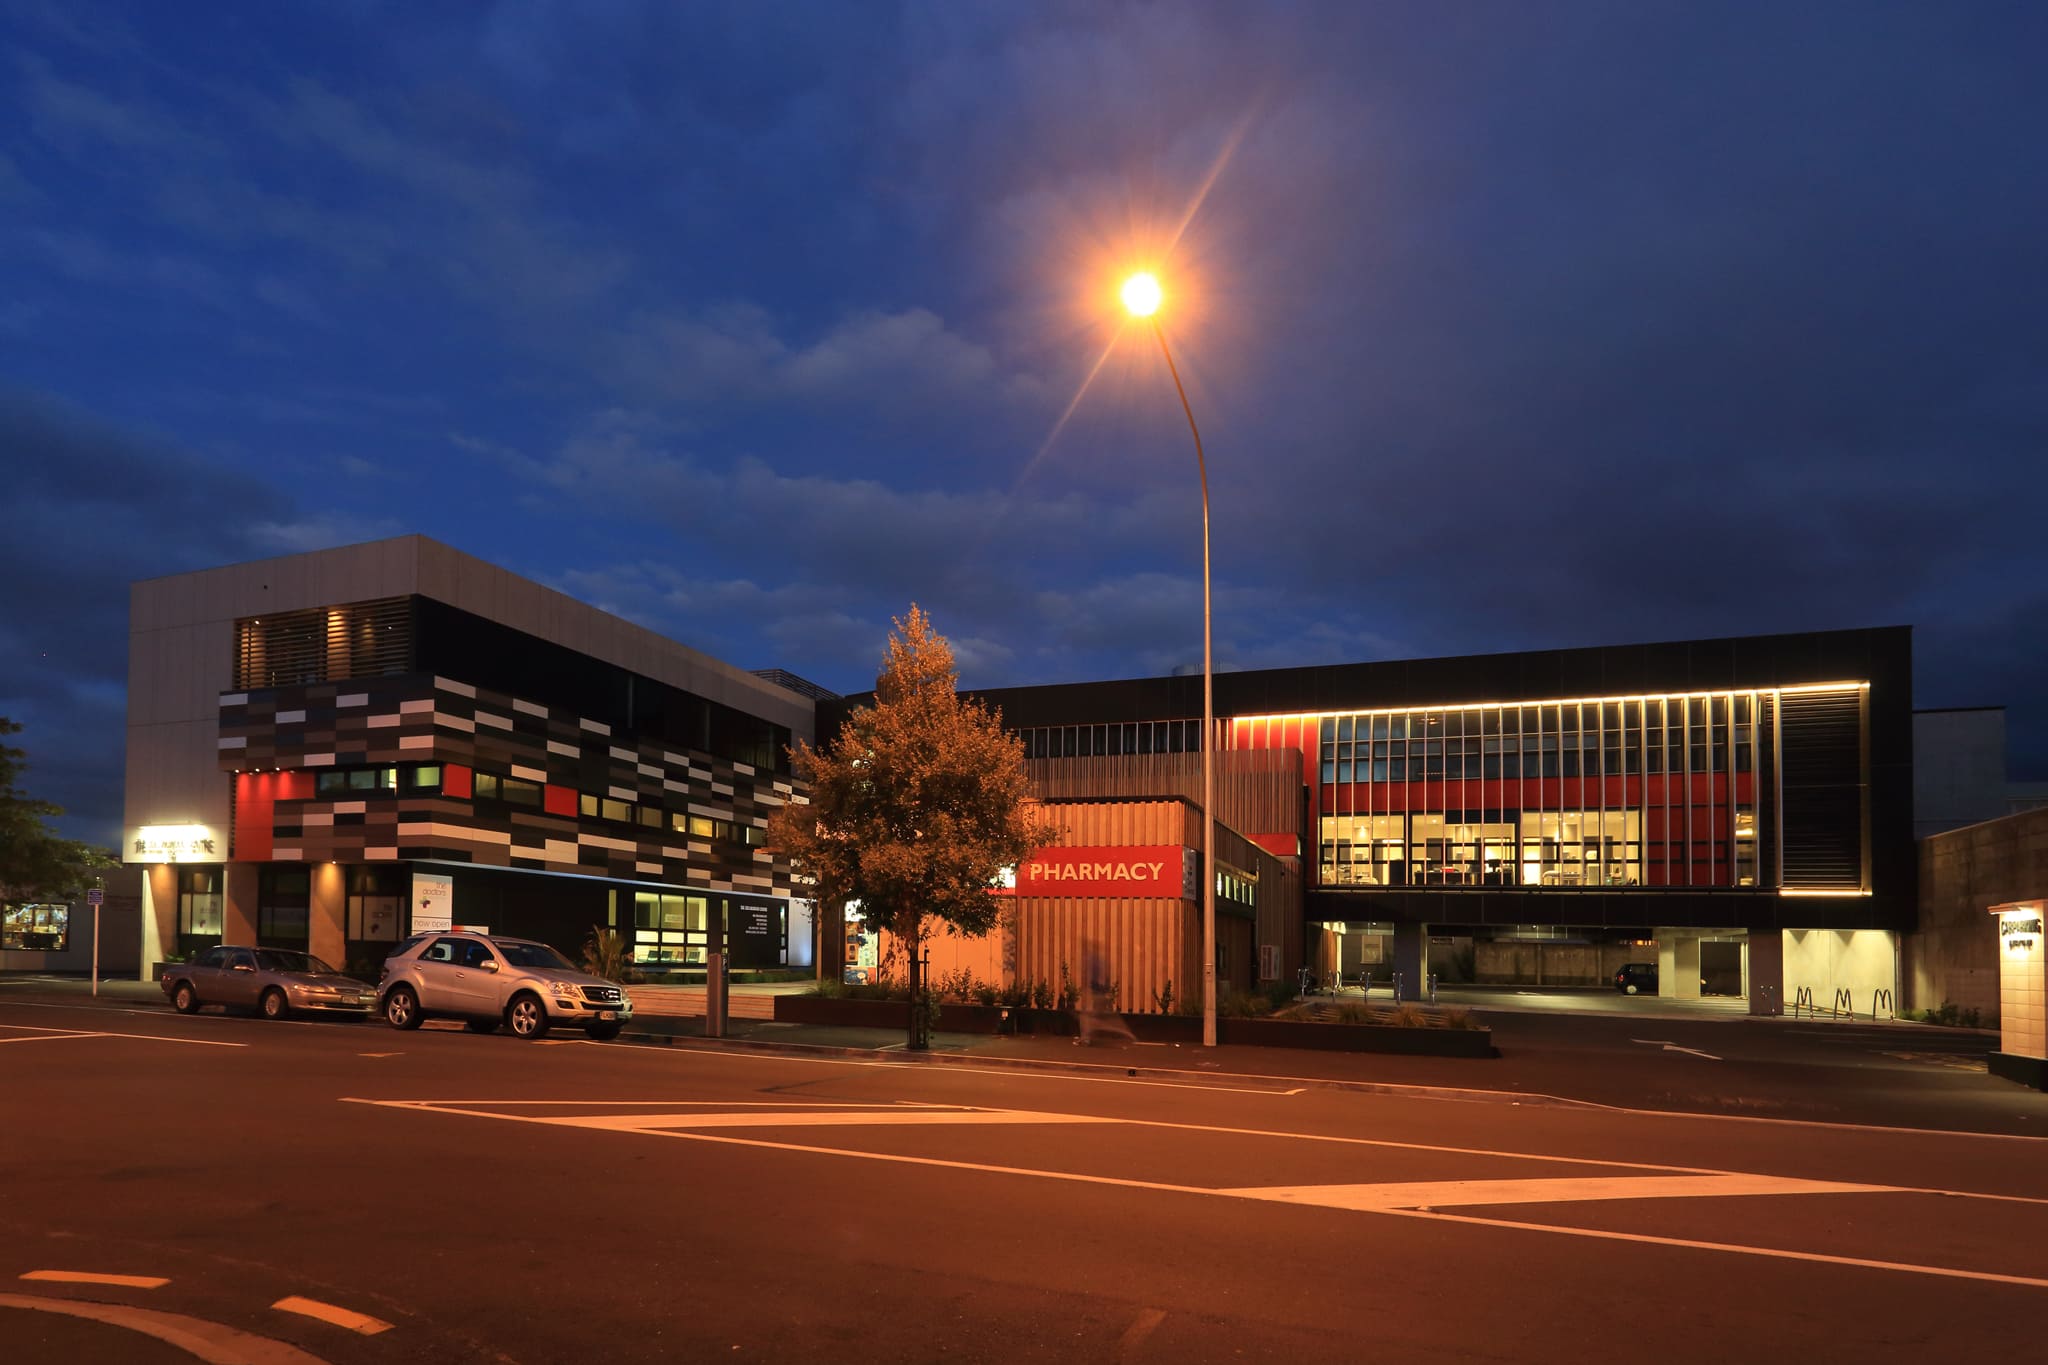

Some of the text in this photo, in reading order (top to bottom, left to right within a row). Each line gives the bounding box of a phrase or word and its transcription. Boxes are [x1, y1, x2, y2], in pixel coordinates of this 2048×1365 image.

[1030, 862, 1164, 881] PHARMACY
[423, 888, 447, 896] doctors
[432, 920, 450, 929] open
